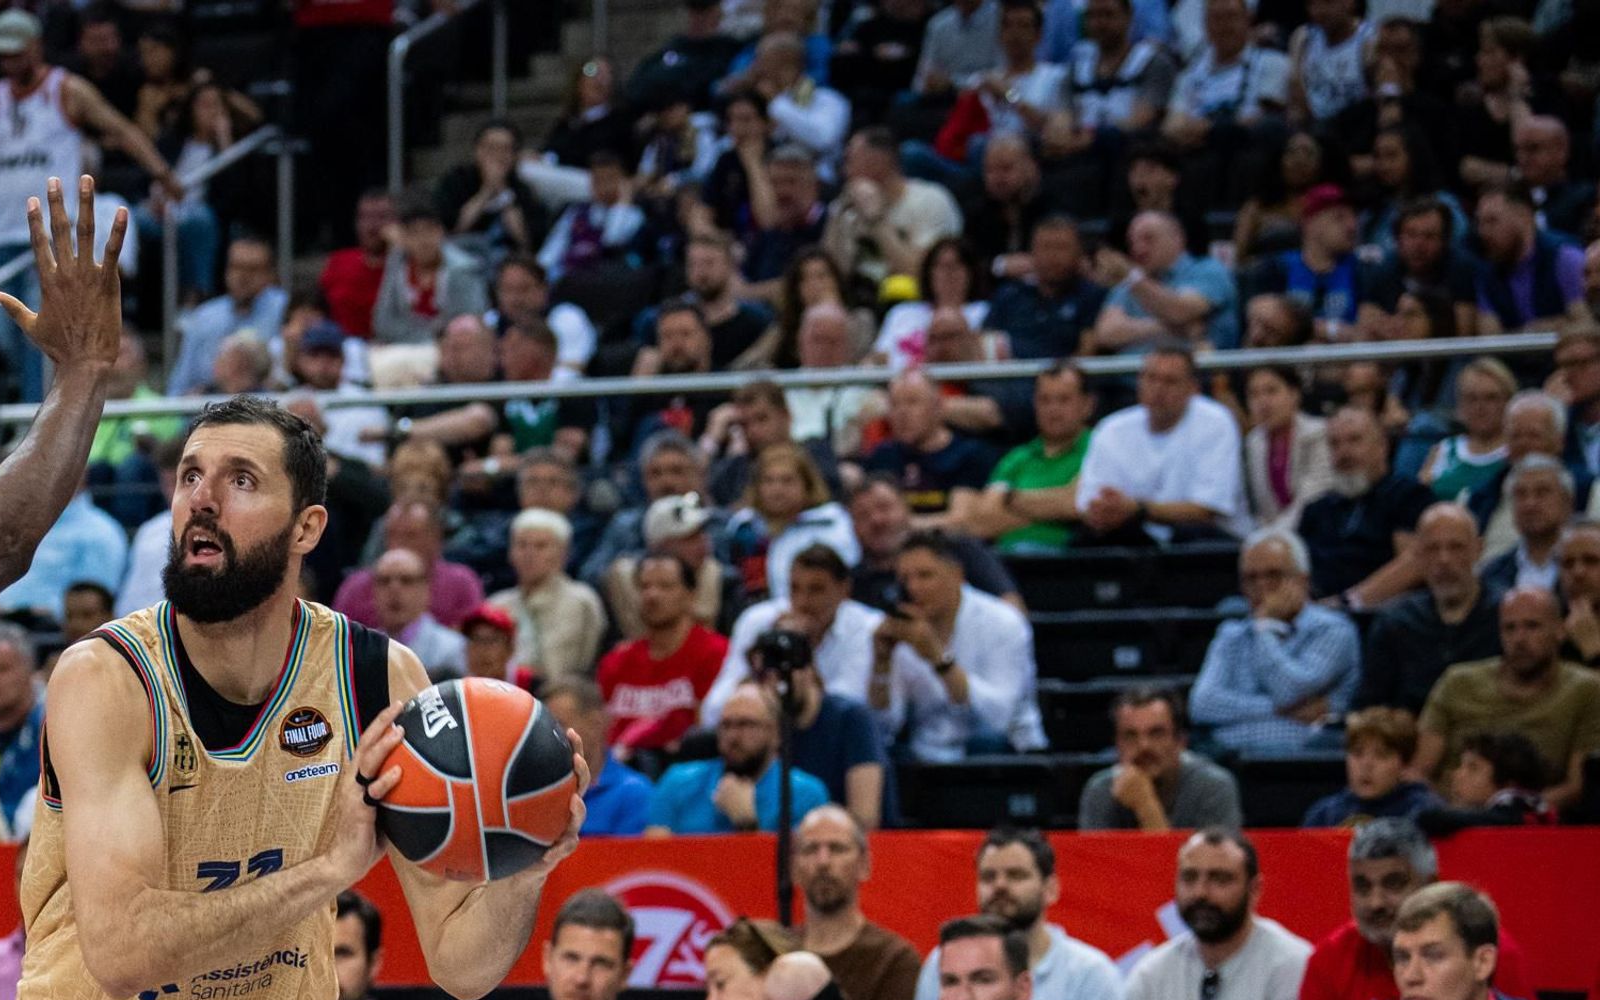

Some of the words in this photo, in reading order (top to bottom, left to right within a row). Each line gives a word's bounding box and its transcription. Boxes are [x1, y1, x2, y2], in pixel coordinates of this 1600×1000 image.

[284, 727, 308, 745] FINAL
[307, 721, 328, 741] FOUR
[285, 763, 339, 781] oneteam
